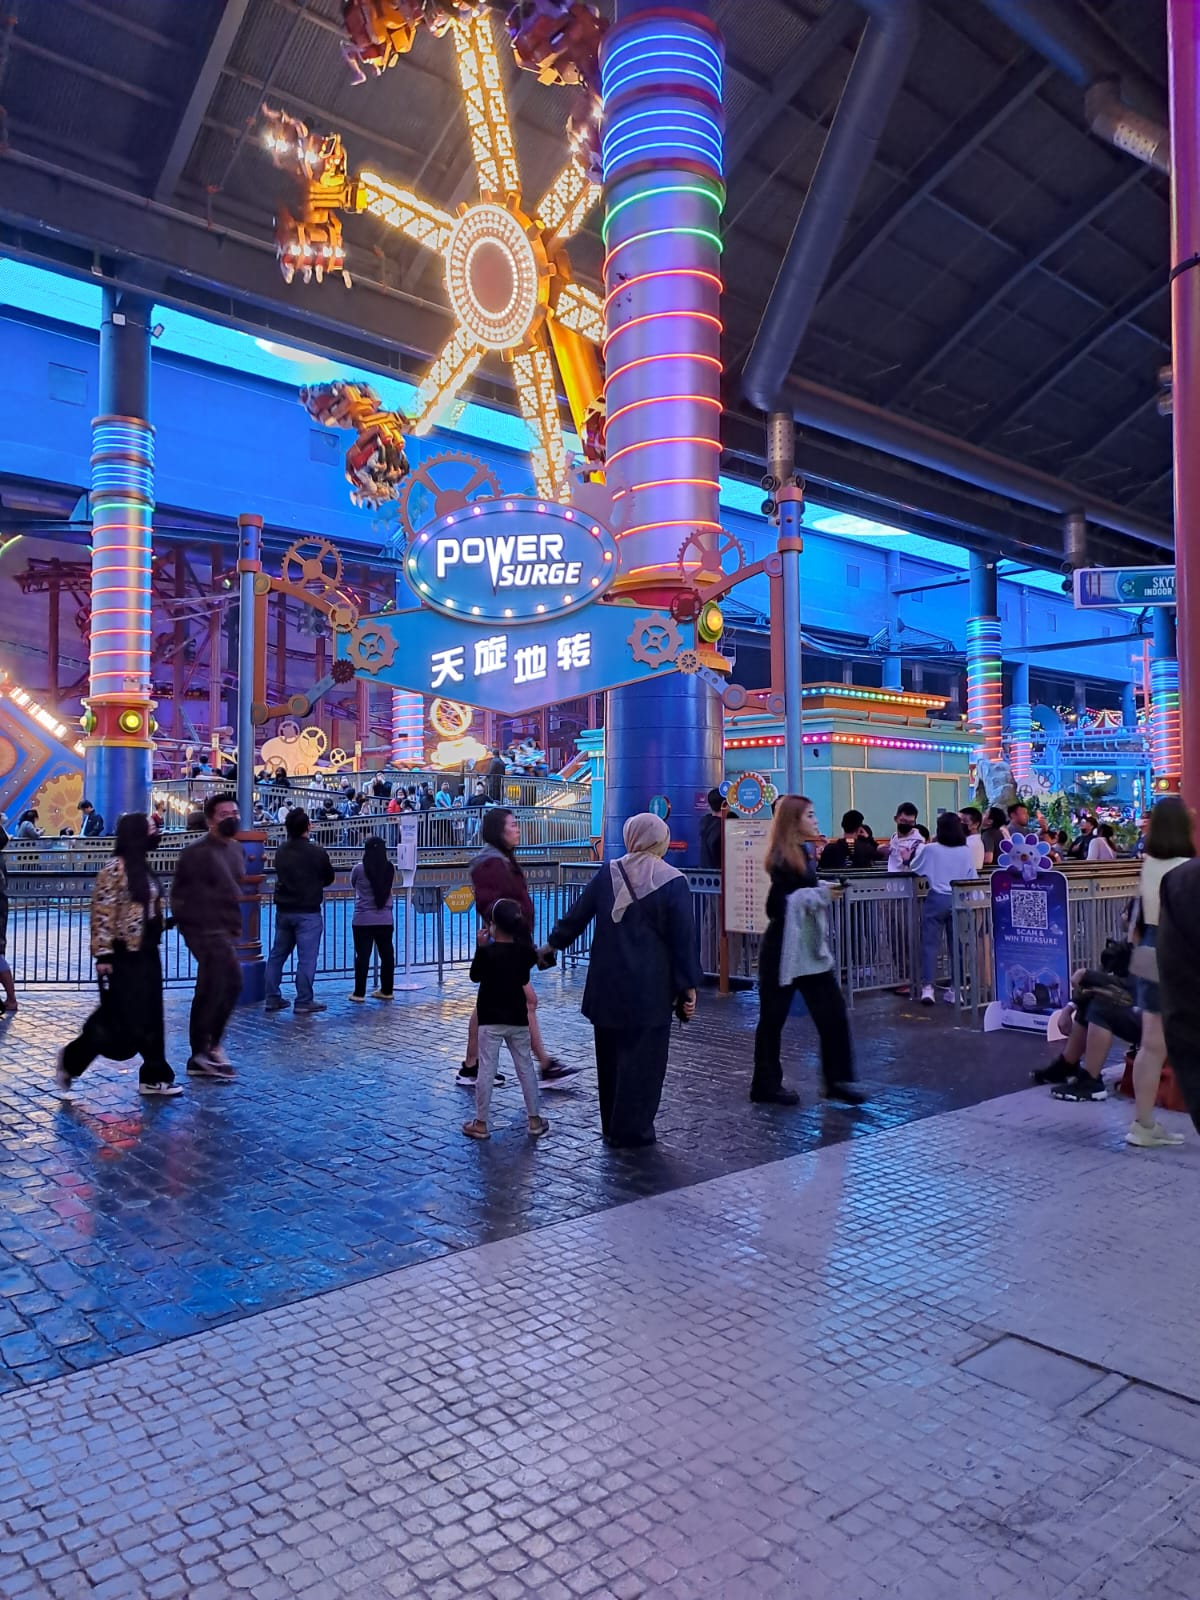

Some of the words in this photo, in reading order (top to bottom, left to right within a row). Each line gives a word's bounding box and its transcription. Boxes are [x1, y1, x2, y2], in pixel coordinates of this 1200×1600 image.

[437, 534, 564, 588] POWER
[498, 562, 582, 587] SURGE
[1144, 588, 1172, 596] INDOOR
[431, 632, 591, 689] 天旋地转
[1020, 936, 1057, 944] TREASURE
